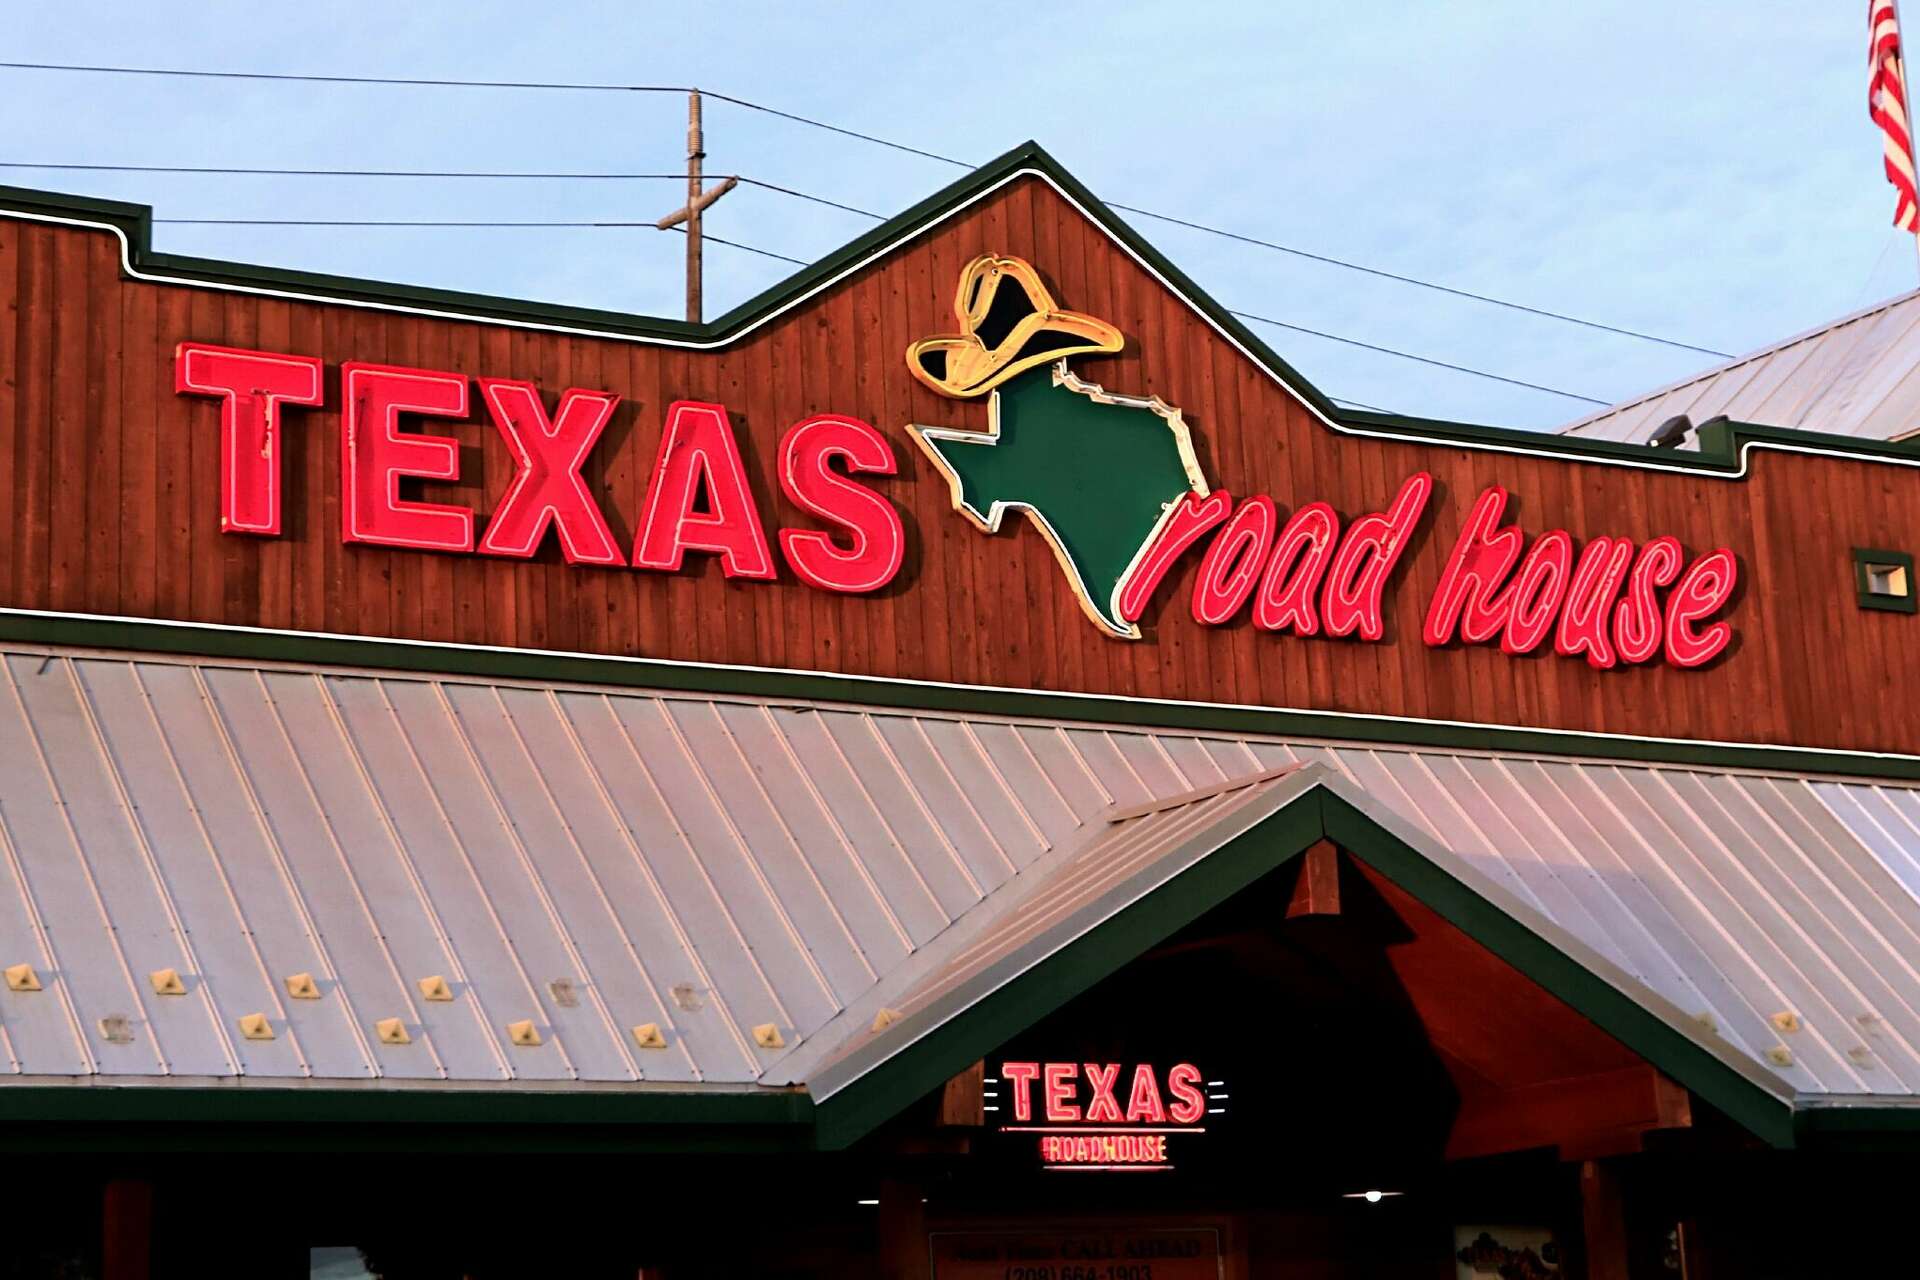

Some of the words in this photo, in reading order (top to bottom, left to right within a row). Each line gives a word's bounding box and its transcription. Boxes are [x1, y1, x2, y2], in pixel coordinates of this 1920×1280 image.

[175, 342, 905, 592] TEXAS
[1120, 471, 1433, 641] road
[1423, 485, 1737, 669] house
[1002, 1062, 1205, 1123] TEXAS
[1043, 1135, 1167, 1162] ROADHOUSE
